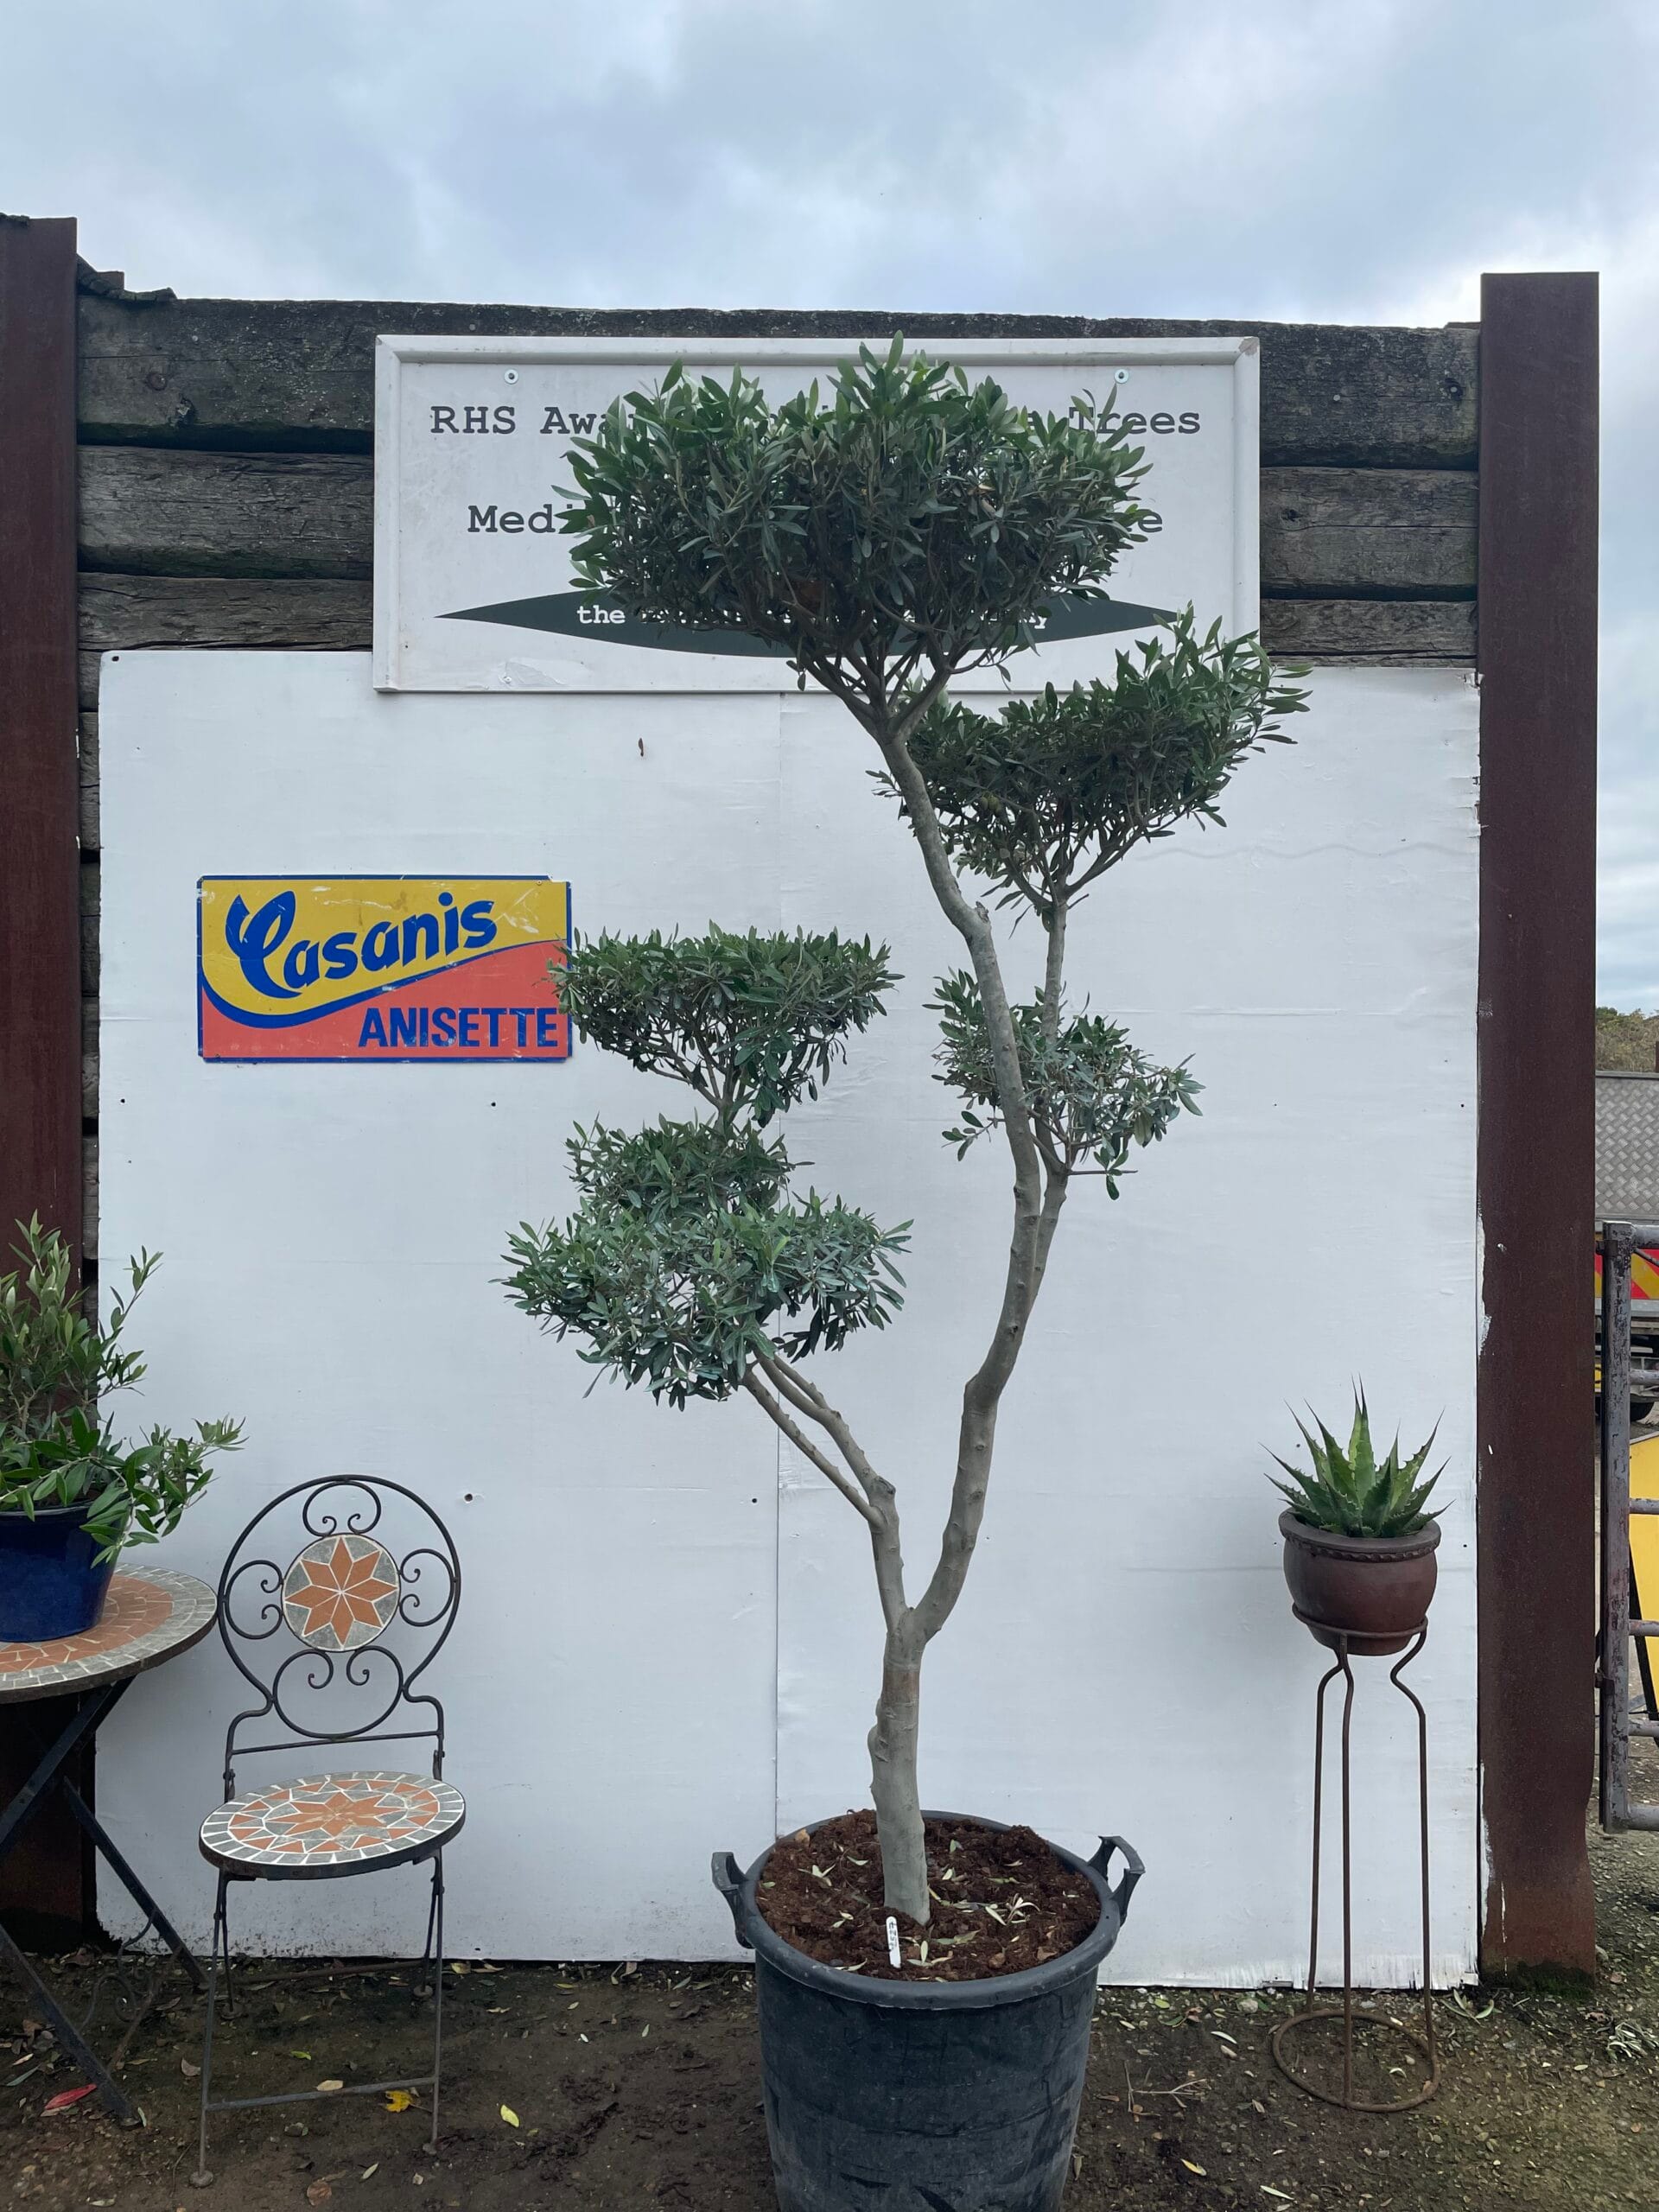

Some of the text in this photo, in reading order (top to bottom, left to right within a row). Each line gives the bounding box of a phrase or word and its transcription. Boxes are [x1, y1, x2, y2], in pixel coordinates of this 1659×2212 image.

[430, 405, 517, 435] RHS
[1068, 406, 1201, 435] Trees
[576, 604, 626, 625] the
[225, 890, 498, 999] Casanis
[357, 1007, 559, 1048] ANISETTE
